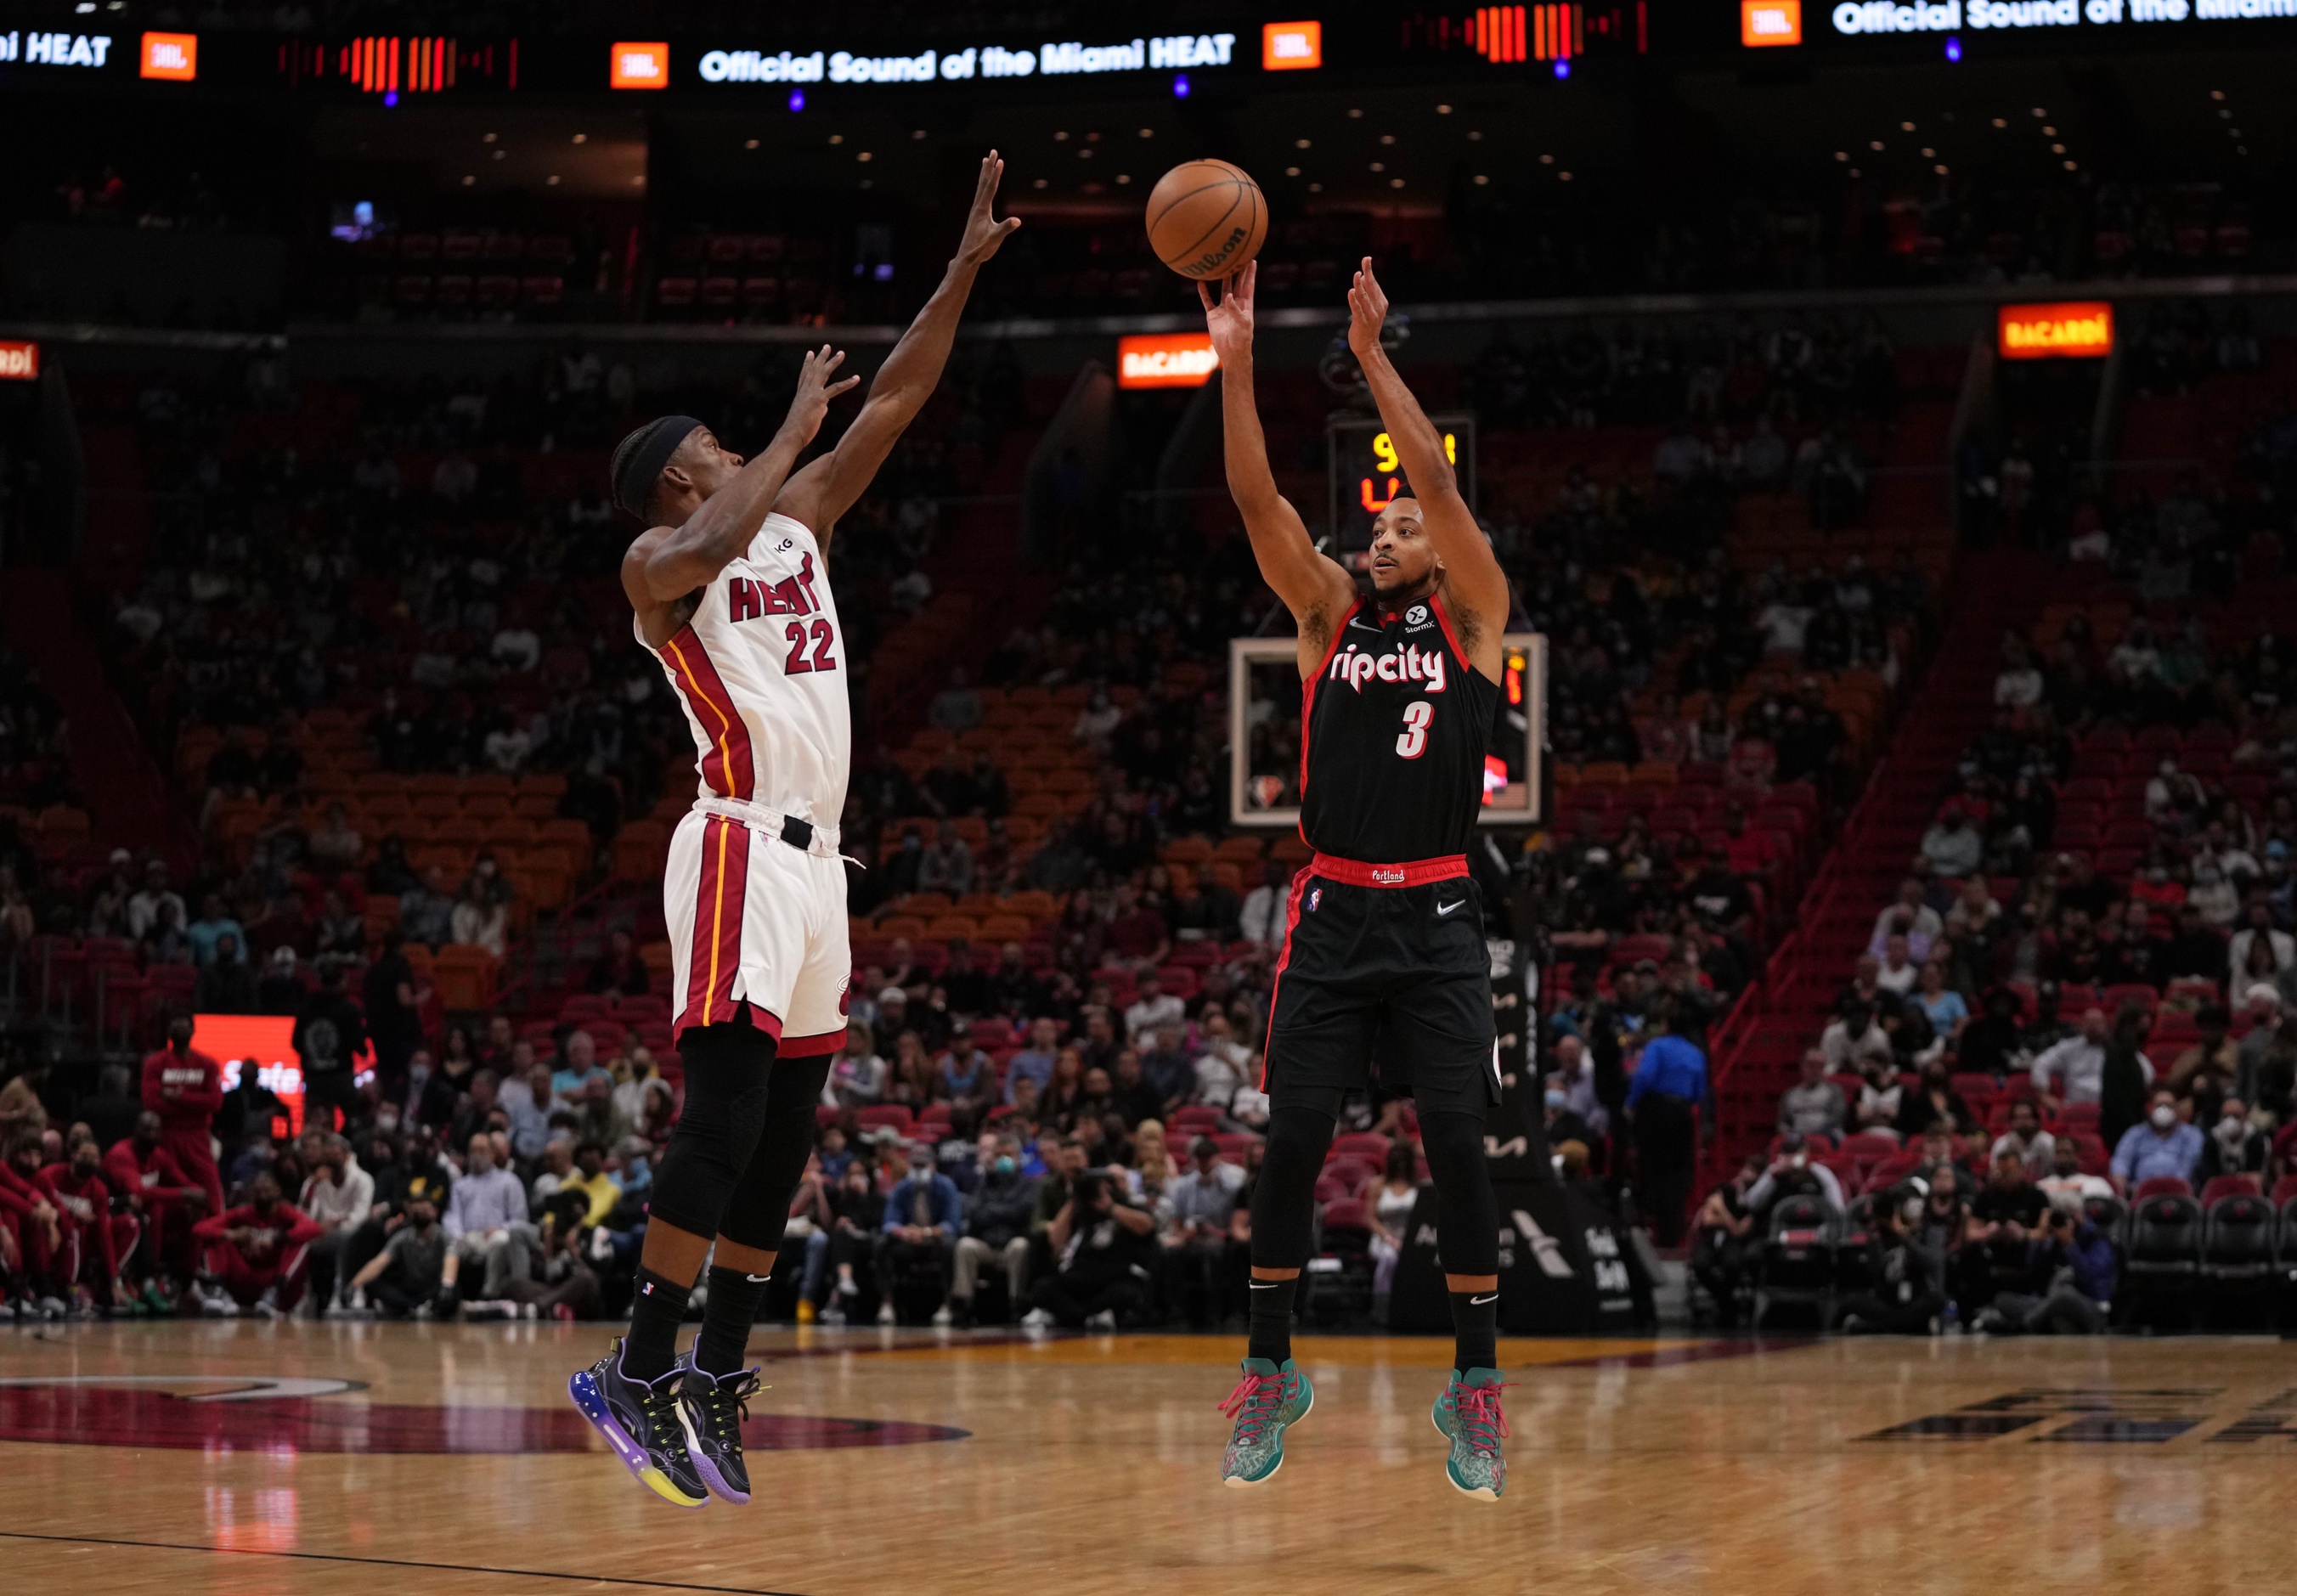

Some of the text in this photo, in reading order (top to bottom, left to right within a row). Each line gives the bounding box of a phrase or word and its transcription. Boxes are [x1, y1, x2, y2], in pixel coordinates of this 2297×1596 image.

[1832, 0, 1961, 34] Official
[1967, 0, 2080, 29] Sound
[25, 31, 111, 67] HEAT
[699, 33, 1235, 82] Official Sound of the Miami HEAT
[1180, 227, 1247, 277] Wilson
[729, 550, 821, 623] HEAT
[784, 618, 837, 676] 22
[1404, 620, 1435, 634] StormX
[1329, 642, 1446, 695] ripcity
[1396, 701, 1435, 759] 3
[1372, 869, 1405, 884] Portland
